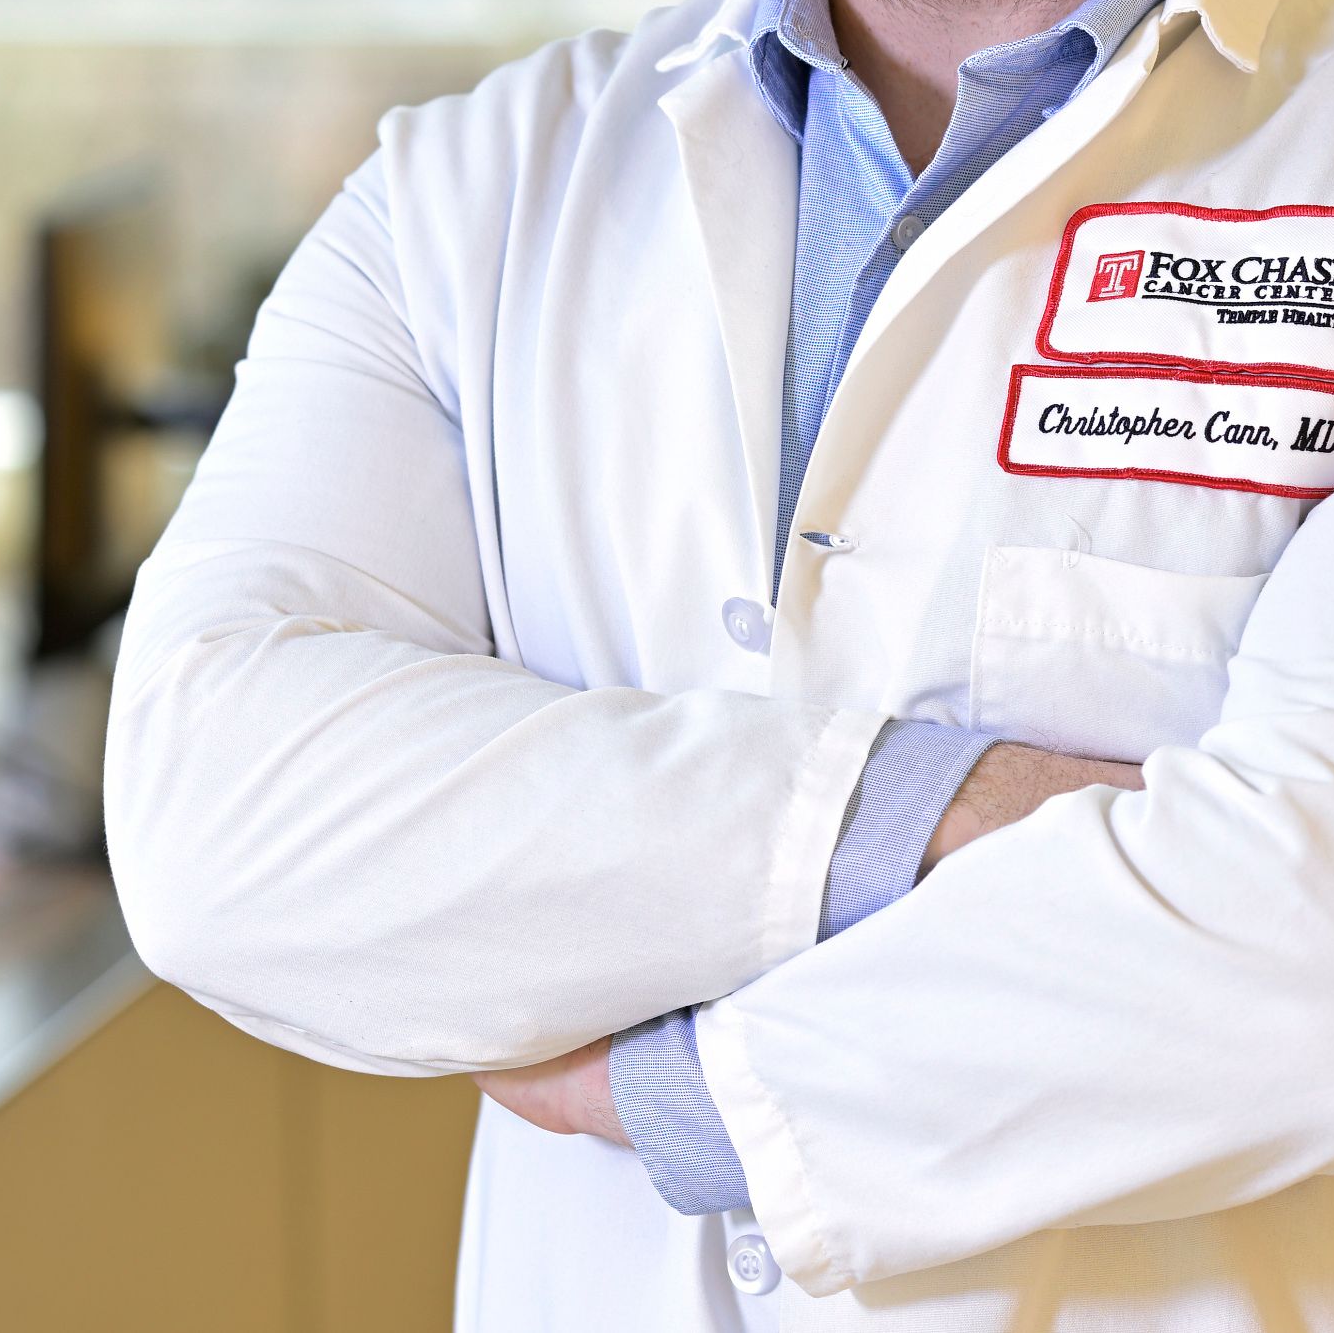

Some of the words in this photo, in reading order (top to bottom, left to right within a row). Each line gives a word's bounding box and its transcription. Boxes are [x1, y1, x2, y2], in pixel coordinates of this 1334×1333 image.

[1146, 251, 1226, 283] FOX
[1143, 279, 1241, 299] CANCER
[1216, 308, 1279, 324] TEMPLE
[1038, 403, 1196, 444] Christopher
[1204, 410, 1279, 451] Cann,
